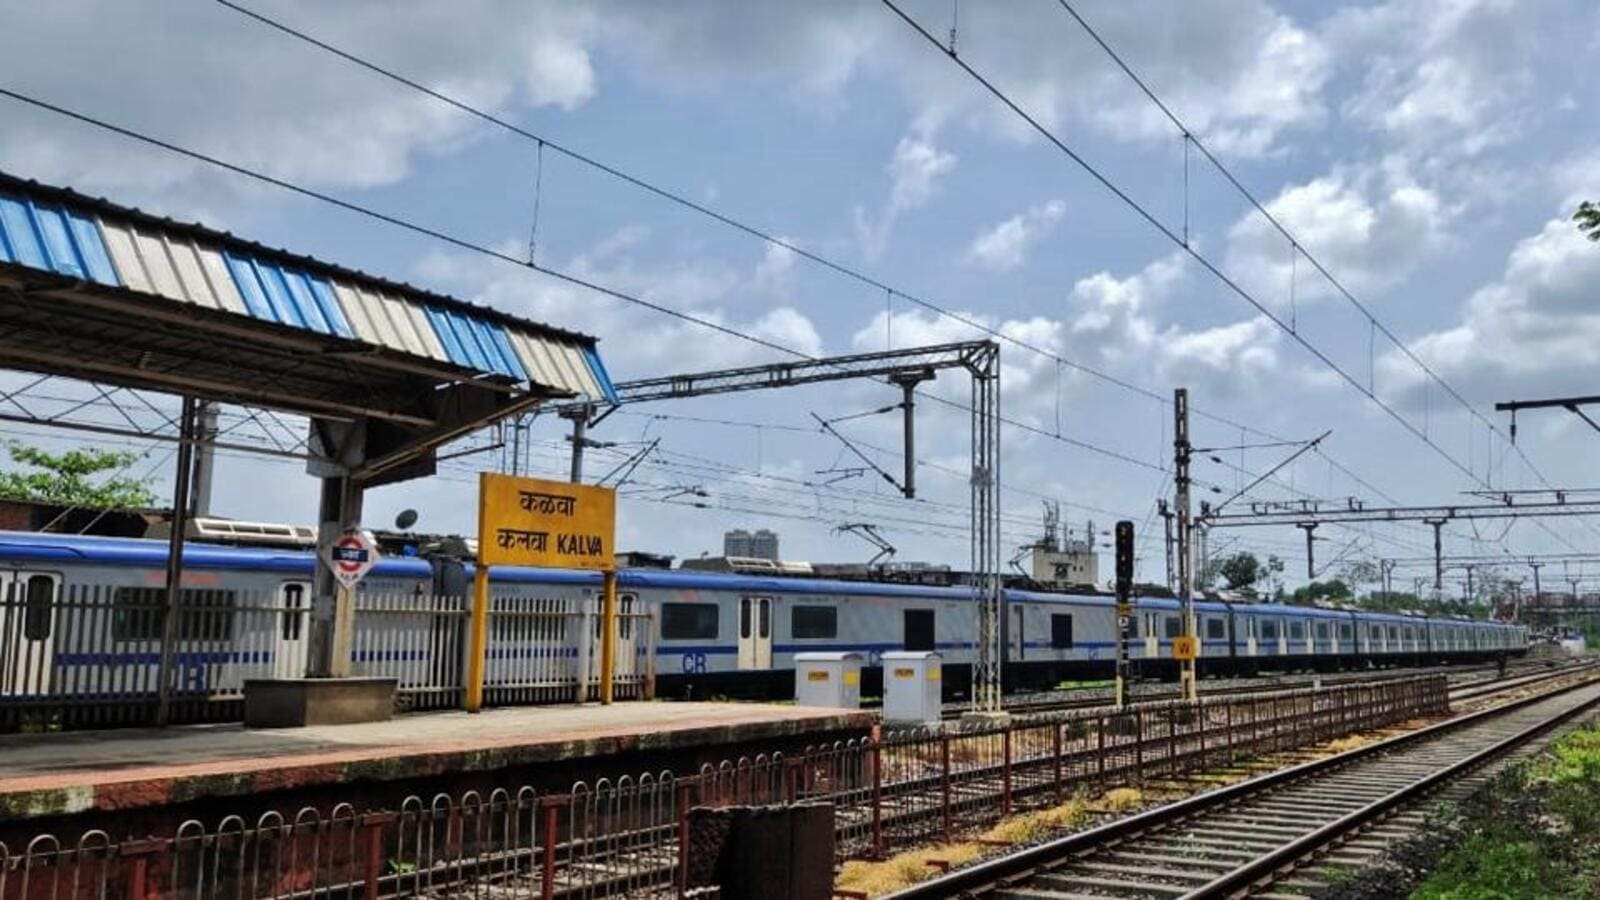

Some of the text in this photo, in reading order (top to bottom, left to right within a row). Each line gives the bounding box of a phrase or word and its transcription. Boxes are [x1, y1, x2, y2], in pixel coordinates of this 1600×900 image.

[518, 490, 577, 516] कळवा
[496, 528, 550, 552] कलवा
[556, 533, 603, 556] KALVA
[682, 653, 706, 673] CR
